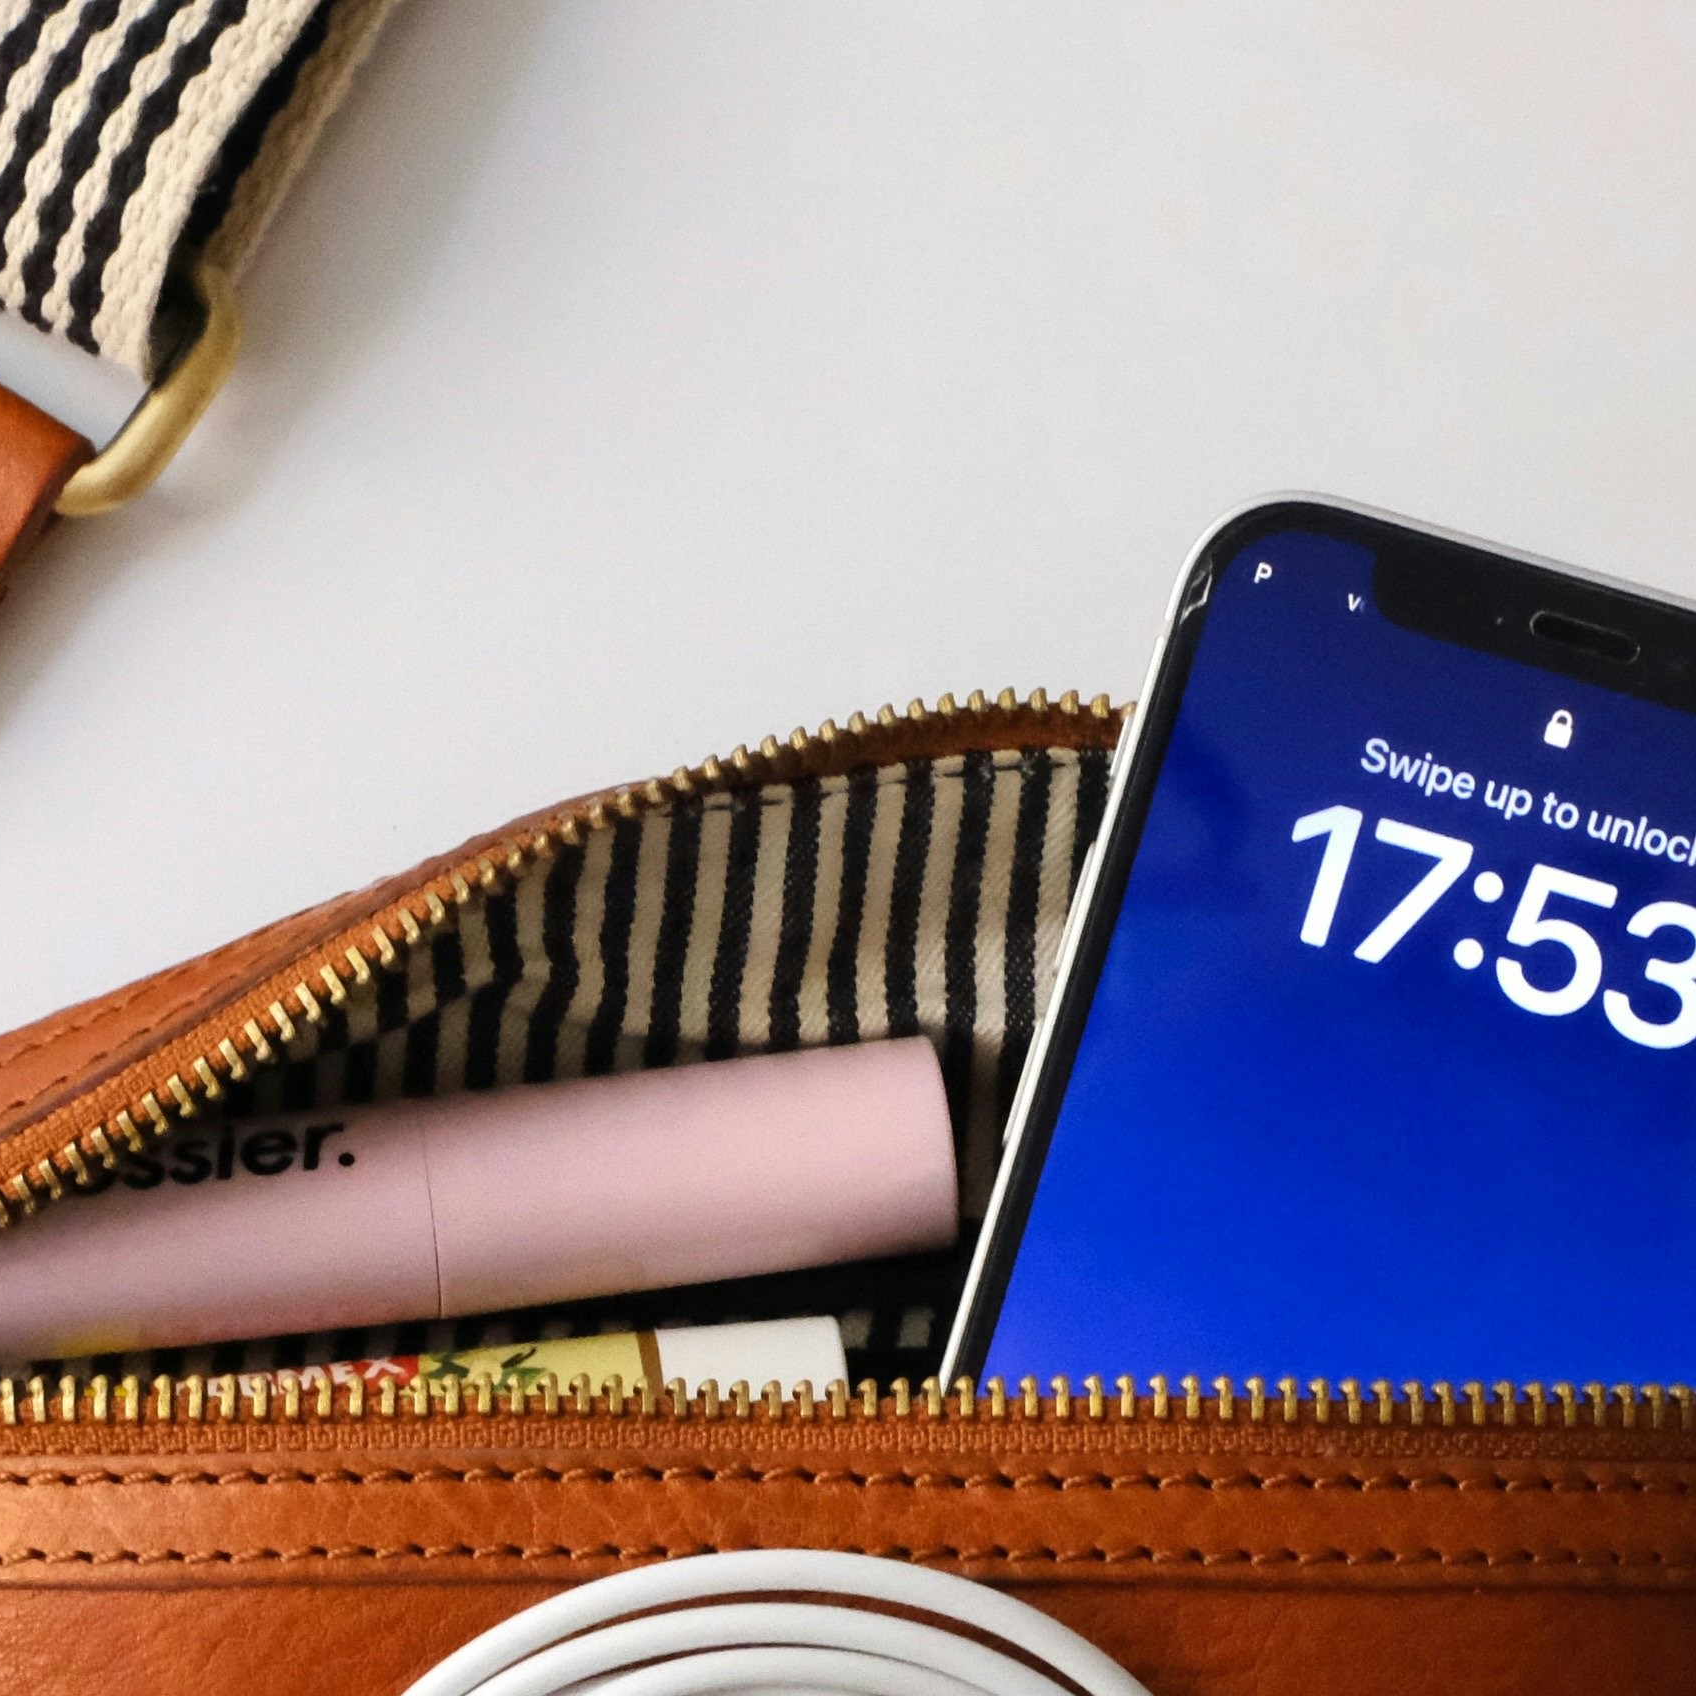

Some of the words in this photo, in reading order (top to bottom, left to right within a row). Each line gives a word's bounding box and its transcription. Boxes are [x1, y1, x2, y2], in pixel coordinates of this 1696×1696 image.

[1253, 561, 1273, 584] P
[1360, 737, 1476, 800] Swipe
[1483, 780, 1533, 821] up
[1541, 791, 1580, 830] to
